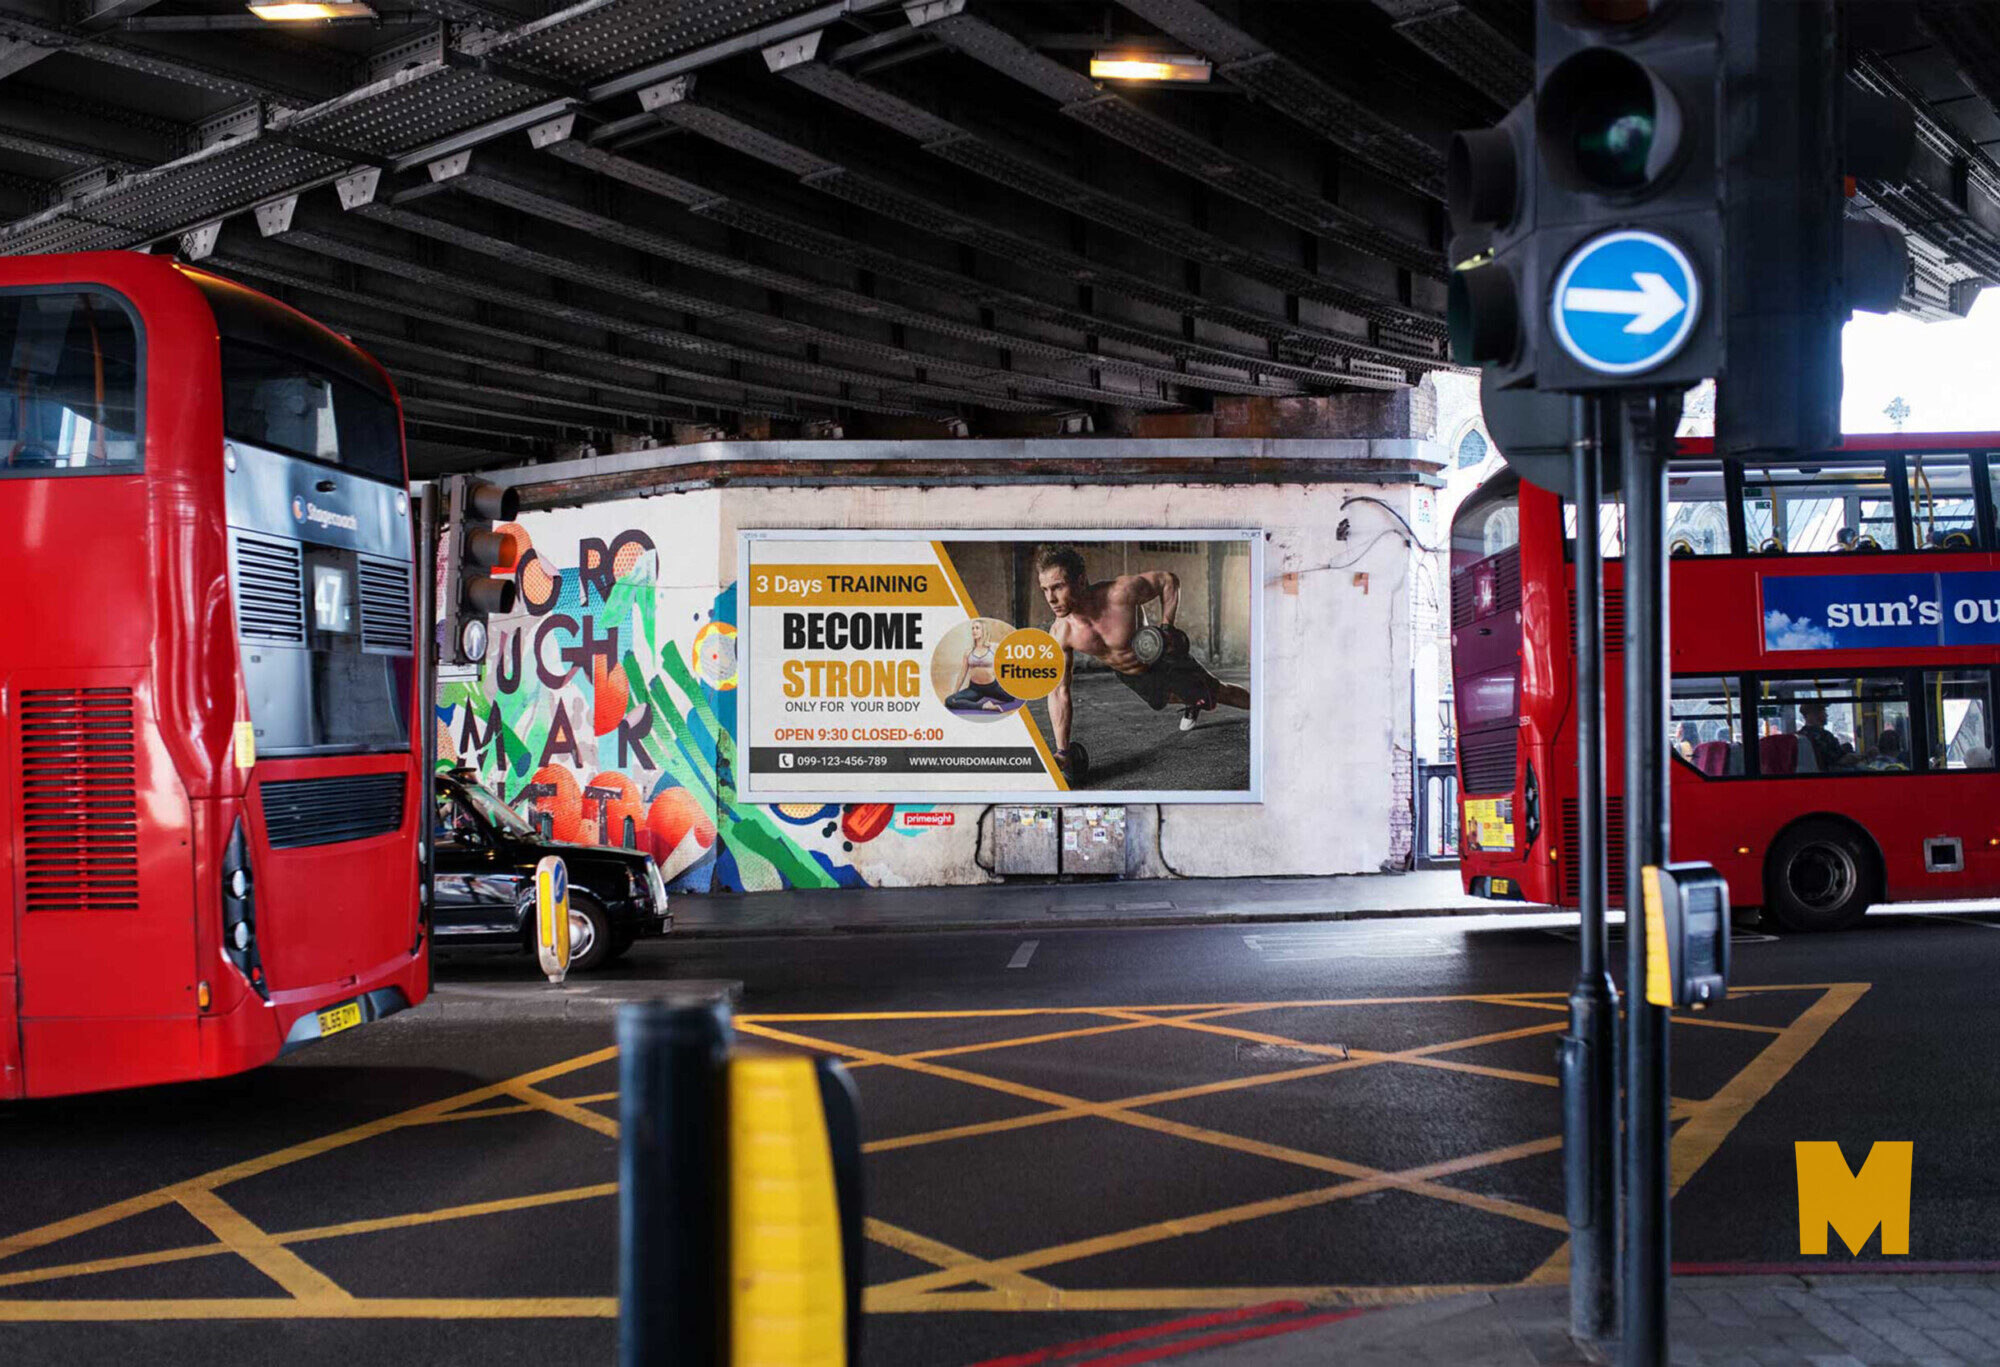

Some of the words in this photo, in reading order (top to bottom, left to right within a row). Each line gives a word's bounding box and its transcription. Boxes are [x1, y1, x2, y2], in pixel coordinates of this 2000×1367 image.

[756, 575, 769, 593] 3
[774, 575, 823, 598] Days
[827, 575, 928, 593] TRAINING
[314, 574, 342, 626] 47
[1826, 594, 1943, 628] sun's
[783, 612, 923, 651] BECOME
[1004, 644, 1036, 660] 100
[1038, 644, 1055, 660] %
[782, 659, 921, 699] STRONG
[1000, 663, 1058, 679] Fitness
[785, 701, 817, 713] ONLY
[820, 701, 845, 713] FOR
[851, 701, 884, 713] YOUR
[887, 701, 921, 713] BODY
[774, 728, 814, 741] OPEN
[818, 728, 848, 741] 9:30
[852, 728, 944, 741] CLOSED-6:00
[797, 755, 888, 766] 099-123-456-789
[909, 756, 1032, 767] WWW.YOURDOMAIN.COM
[907, 814, 952, 825] primesight
